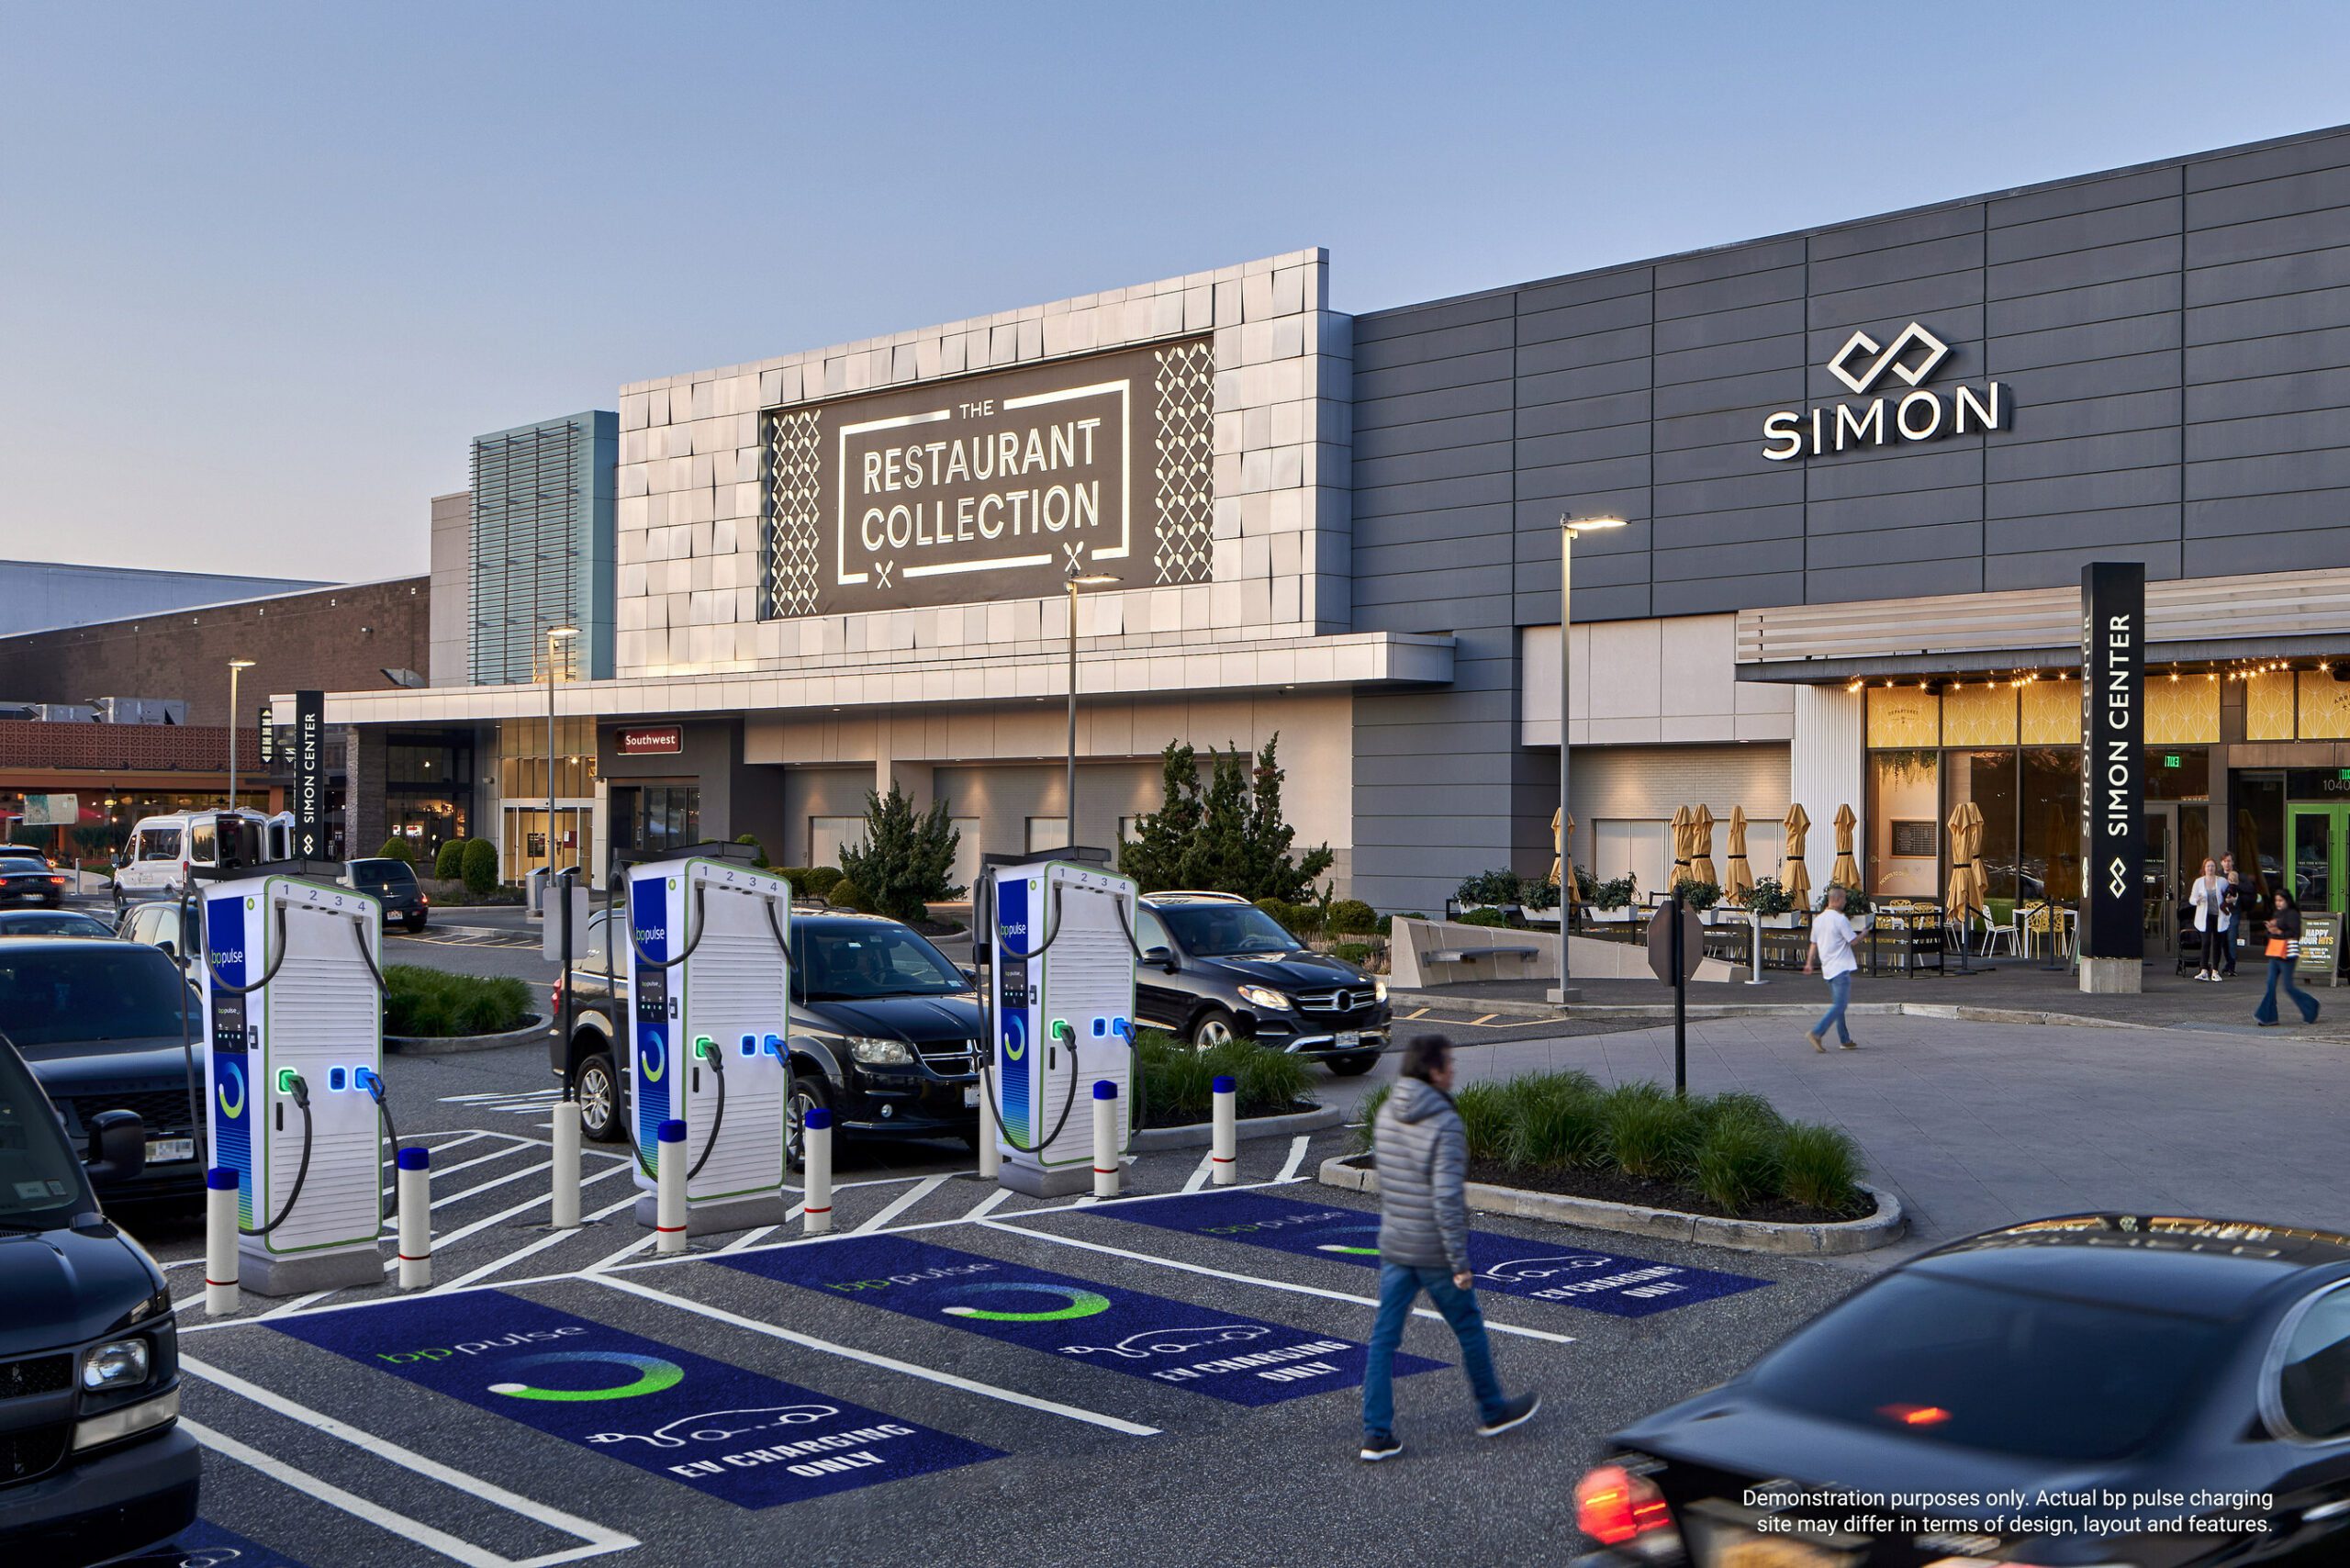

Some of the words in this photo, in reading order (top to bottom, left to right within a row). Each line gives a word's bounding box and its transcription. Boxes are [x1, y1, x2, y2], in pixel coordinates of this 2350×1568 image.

[959, 399, 994, 419] THE
[1762, 381, 1999, 461] SIMON
[864, 418, 1101, 495] RESTAURANT
[861, 480, 1099, 551] COLLECTION
[2109, 613, 2130, 730] CENTER
[304, 712, 316, 771] CENTER
[625, 734, 676, 745] Southwest
[304, 775, 315, 823] SIMON
[2109, 741, 2129, 836] SIMON
[2323, 779, 2350, 791] 1040
[702, 866, 708, 876] 1
[726, 871, 733, 881] 2
[749, 877, 756, 887] 3
[770, 881, 778, 891] 4
[1059, 868, 1065, 878] 1
[1080, 873, 1088, 882] 2
[1102, 877, 1108, 887] 3
[1119, 881, 1126, 890] 4
[284, 884, 289, 894] 1
[309, 890, 318, 901] 2
[335, 896, 342, 906] 3
[358, 902, 366, 912] 4
[2305, 929, 2329, 937] HAPPY
[2318, 936, 2333, 945] HITS
[1529, 1288, 1578, 1299] EV
[1562, 1266, 1685, 1293] CHARGING
[1621, 1282, 1689, 1298] ONLY
[1152, 1367, 1202, 1382] EV
[1192, 1340, 1352, 1373] CHARGING
[1258, 1361, 1341, 1382] ONLY
[666, 1460, 726, 1478] EV
[722, 1424, 917, 1467] CHARGING
[787, 1450, 886, 1477] ONLY
